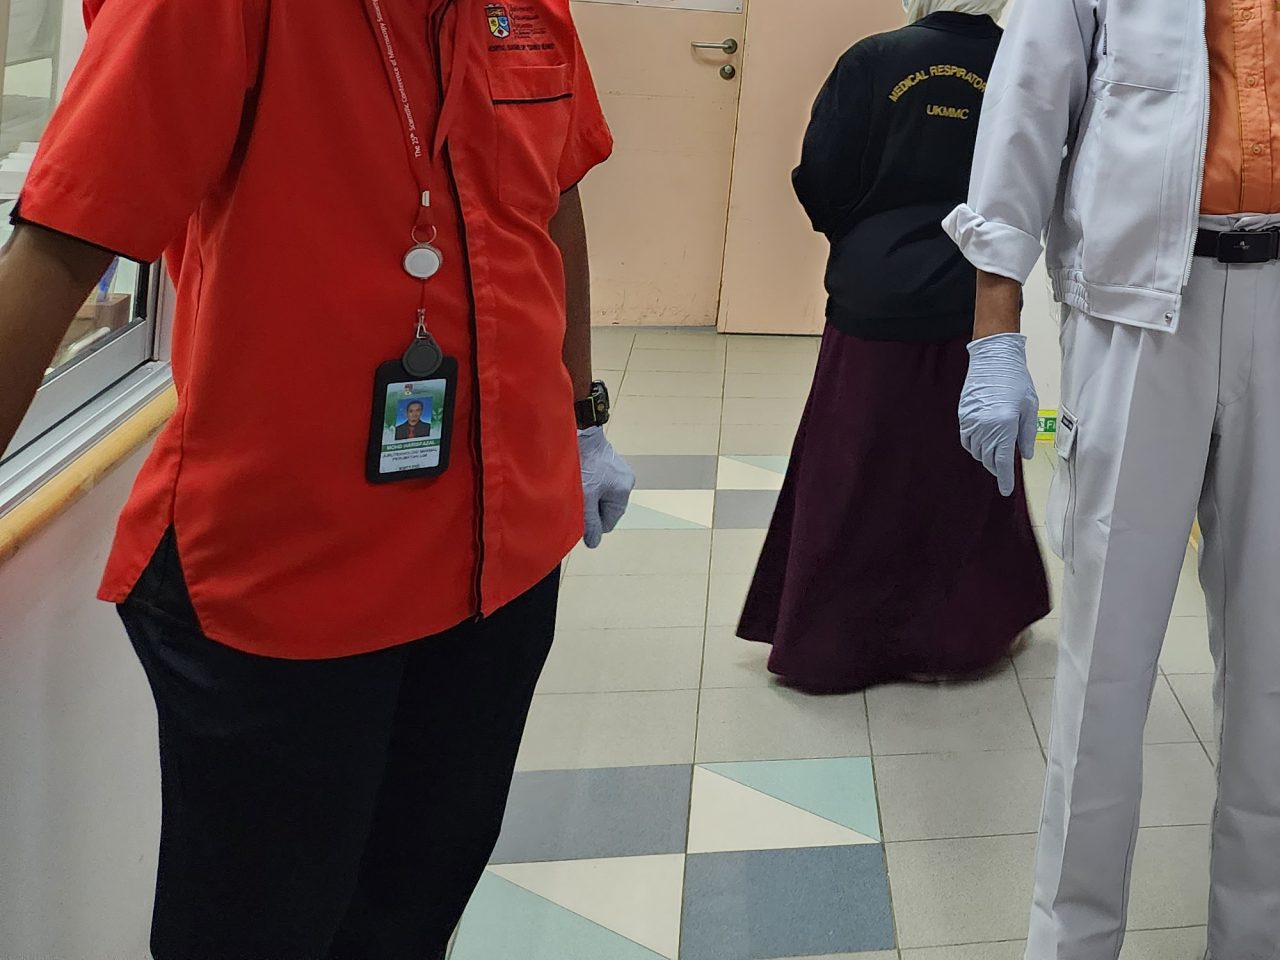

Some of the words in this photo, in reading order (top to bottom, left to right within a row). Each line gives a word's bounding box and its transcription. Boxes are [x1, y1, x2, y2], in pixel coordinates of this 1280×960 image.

[380, 23, 395, 58] Microscopy
[394, 67, 408, 102] Conference
[889, 70, 929, 102] MEDICAL
[404, 103, 416, 131] Scientific
[926, 104, 970, 119] UKMMC
